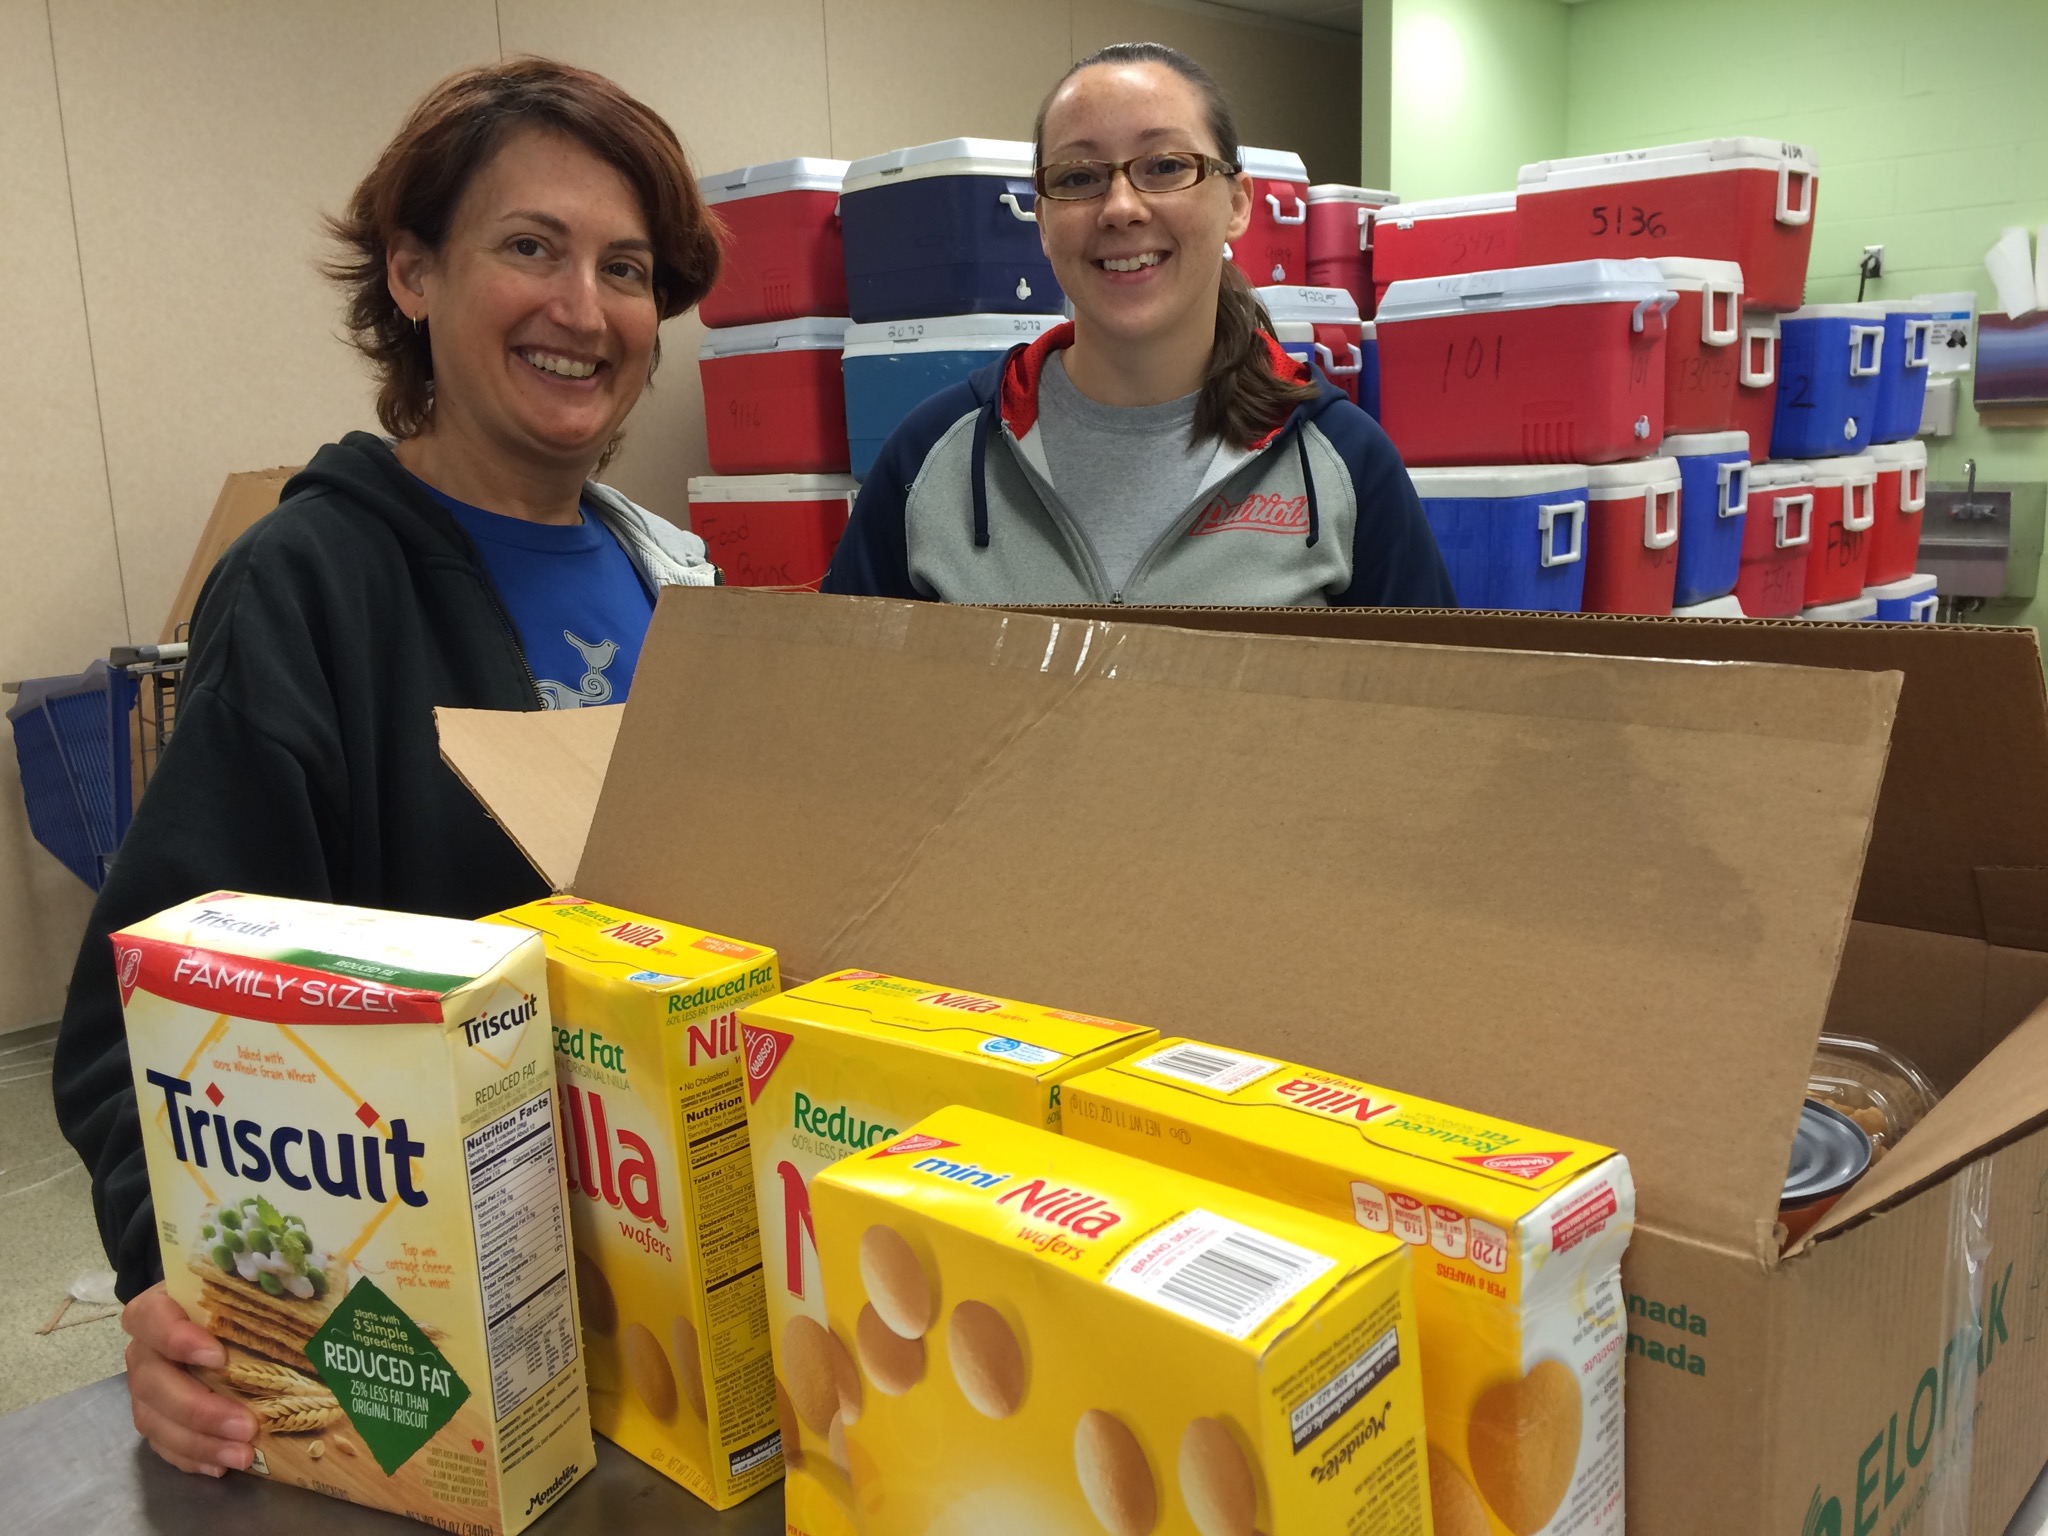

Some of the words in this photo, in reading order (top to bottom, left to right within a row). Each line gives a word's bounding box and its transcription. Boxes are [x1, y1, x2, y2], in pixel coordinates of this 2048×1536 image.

[1589, 205, 1667, 239] 5136
[1298, 288, 1337, 306] 9225
[1013, 319, 1041, 331] 2072
[1442, 334, 1503, 394] 101
[701, 512, 749, 547] Food
[189, 909, 282, 937] Triscuit
[600, 922, 664, 948] Nilla
[173, 957, 299, 1001] FAMILY
[300, 979, 399, 1013] SIZE!
[668, 973, 746, 1015] Reduced
[749, 966, 773, 989] Fat
[682, 1010, 698, 1022] LESS
[698, 1006, 709, 1017] FAT
[710, 1000, 729, 1012] THAN
[729, 990, 759, 1006] ORIGINAL
[759, 983, 776, 996] NILLA
[917, 992, 1002, 1013] Nilla
[458, 993, 538, 1047] Triscuit
[590, 1032, 627, 1074] Fat
[686, 1011, 739, 1067] Nil
[750, 1037, 775, 1076] NABISCO
[475, 1070, 520, 1107] REDUCED
[522, 1060, 537, 1081] FAT
[566, 1062, 607, 1084] ORIGINAL
[606, 1074, 632, 1092] NILLA
[684, 1081, 695, 1091] No
[695, 1068, 730, 1087] Cholesterol
[686, 1095, 743, 1123] Nutrition
[1100, 1105, 1113, 1123] OZ
[1276, 1079, 1398, 1122] Nilla
[146, 1068, 430, 1207] Triscuit
[466, 1116, 517, 1152] Nutrition
[519, 1097, 549, 1121] Facts
[1129, 1114, 1143, 1133] WT
[1145, 1119, 1161, 1138] NET
[1384, 1118, 1502, 1153] Reduced
[1475, 1130, 1521, 1146] Fat
[792, 1133, 813, 1153] 60%
[815, 1143, 836, 1161] LESS
[1487, 1156, 1552, 1169] NABISCO
[912, 1157, 1012, 1189] mini
[995, 1179, 1122, 1240] Nilla
[619, 1221, 672, 1262] wafers
[1016, 1226, 1087, 1261] wafers
[1130, 1243, 1171, 1275] BRAND
[1169, 1225, 1200, 1244] SEAL
[1472, 1239, 1503, 1268] 120
[1436, 1263, 1477, 1288] WAFERS
[1486, 1280, 1507, 1298] PER
[353, 1318, 362, 1331] 3
[362, 1320, 409, 1342] Simple
[354, 1308, 379, 1322] starts
[380, 1313, 400, 1326] with
[1627, 1292, 1708, 1338] nada
[352, 1330, 415, 1356] Ingredients
[1627, 1331, 1707, 1378] nada
[323, 1340, 415, 1387] REDUCED
[420, 1365, 452, 1398] FAT
[350, 1379, 368, 1398] 25%
[369, 1385, 389, 1403] LESS
[389, 1389, 406, 1406] FAT
[405, 1393, 429, 1413] THAN
[352, 1398, 391, 1422] ORIGINAL
[392, 1406, 429, 1430] TRISCUIT
